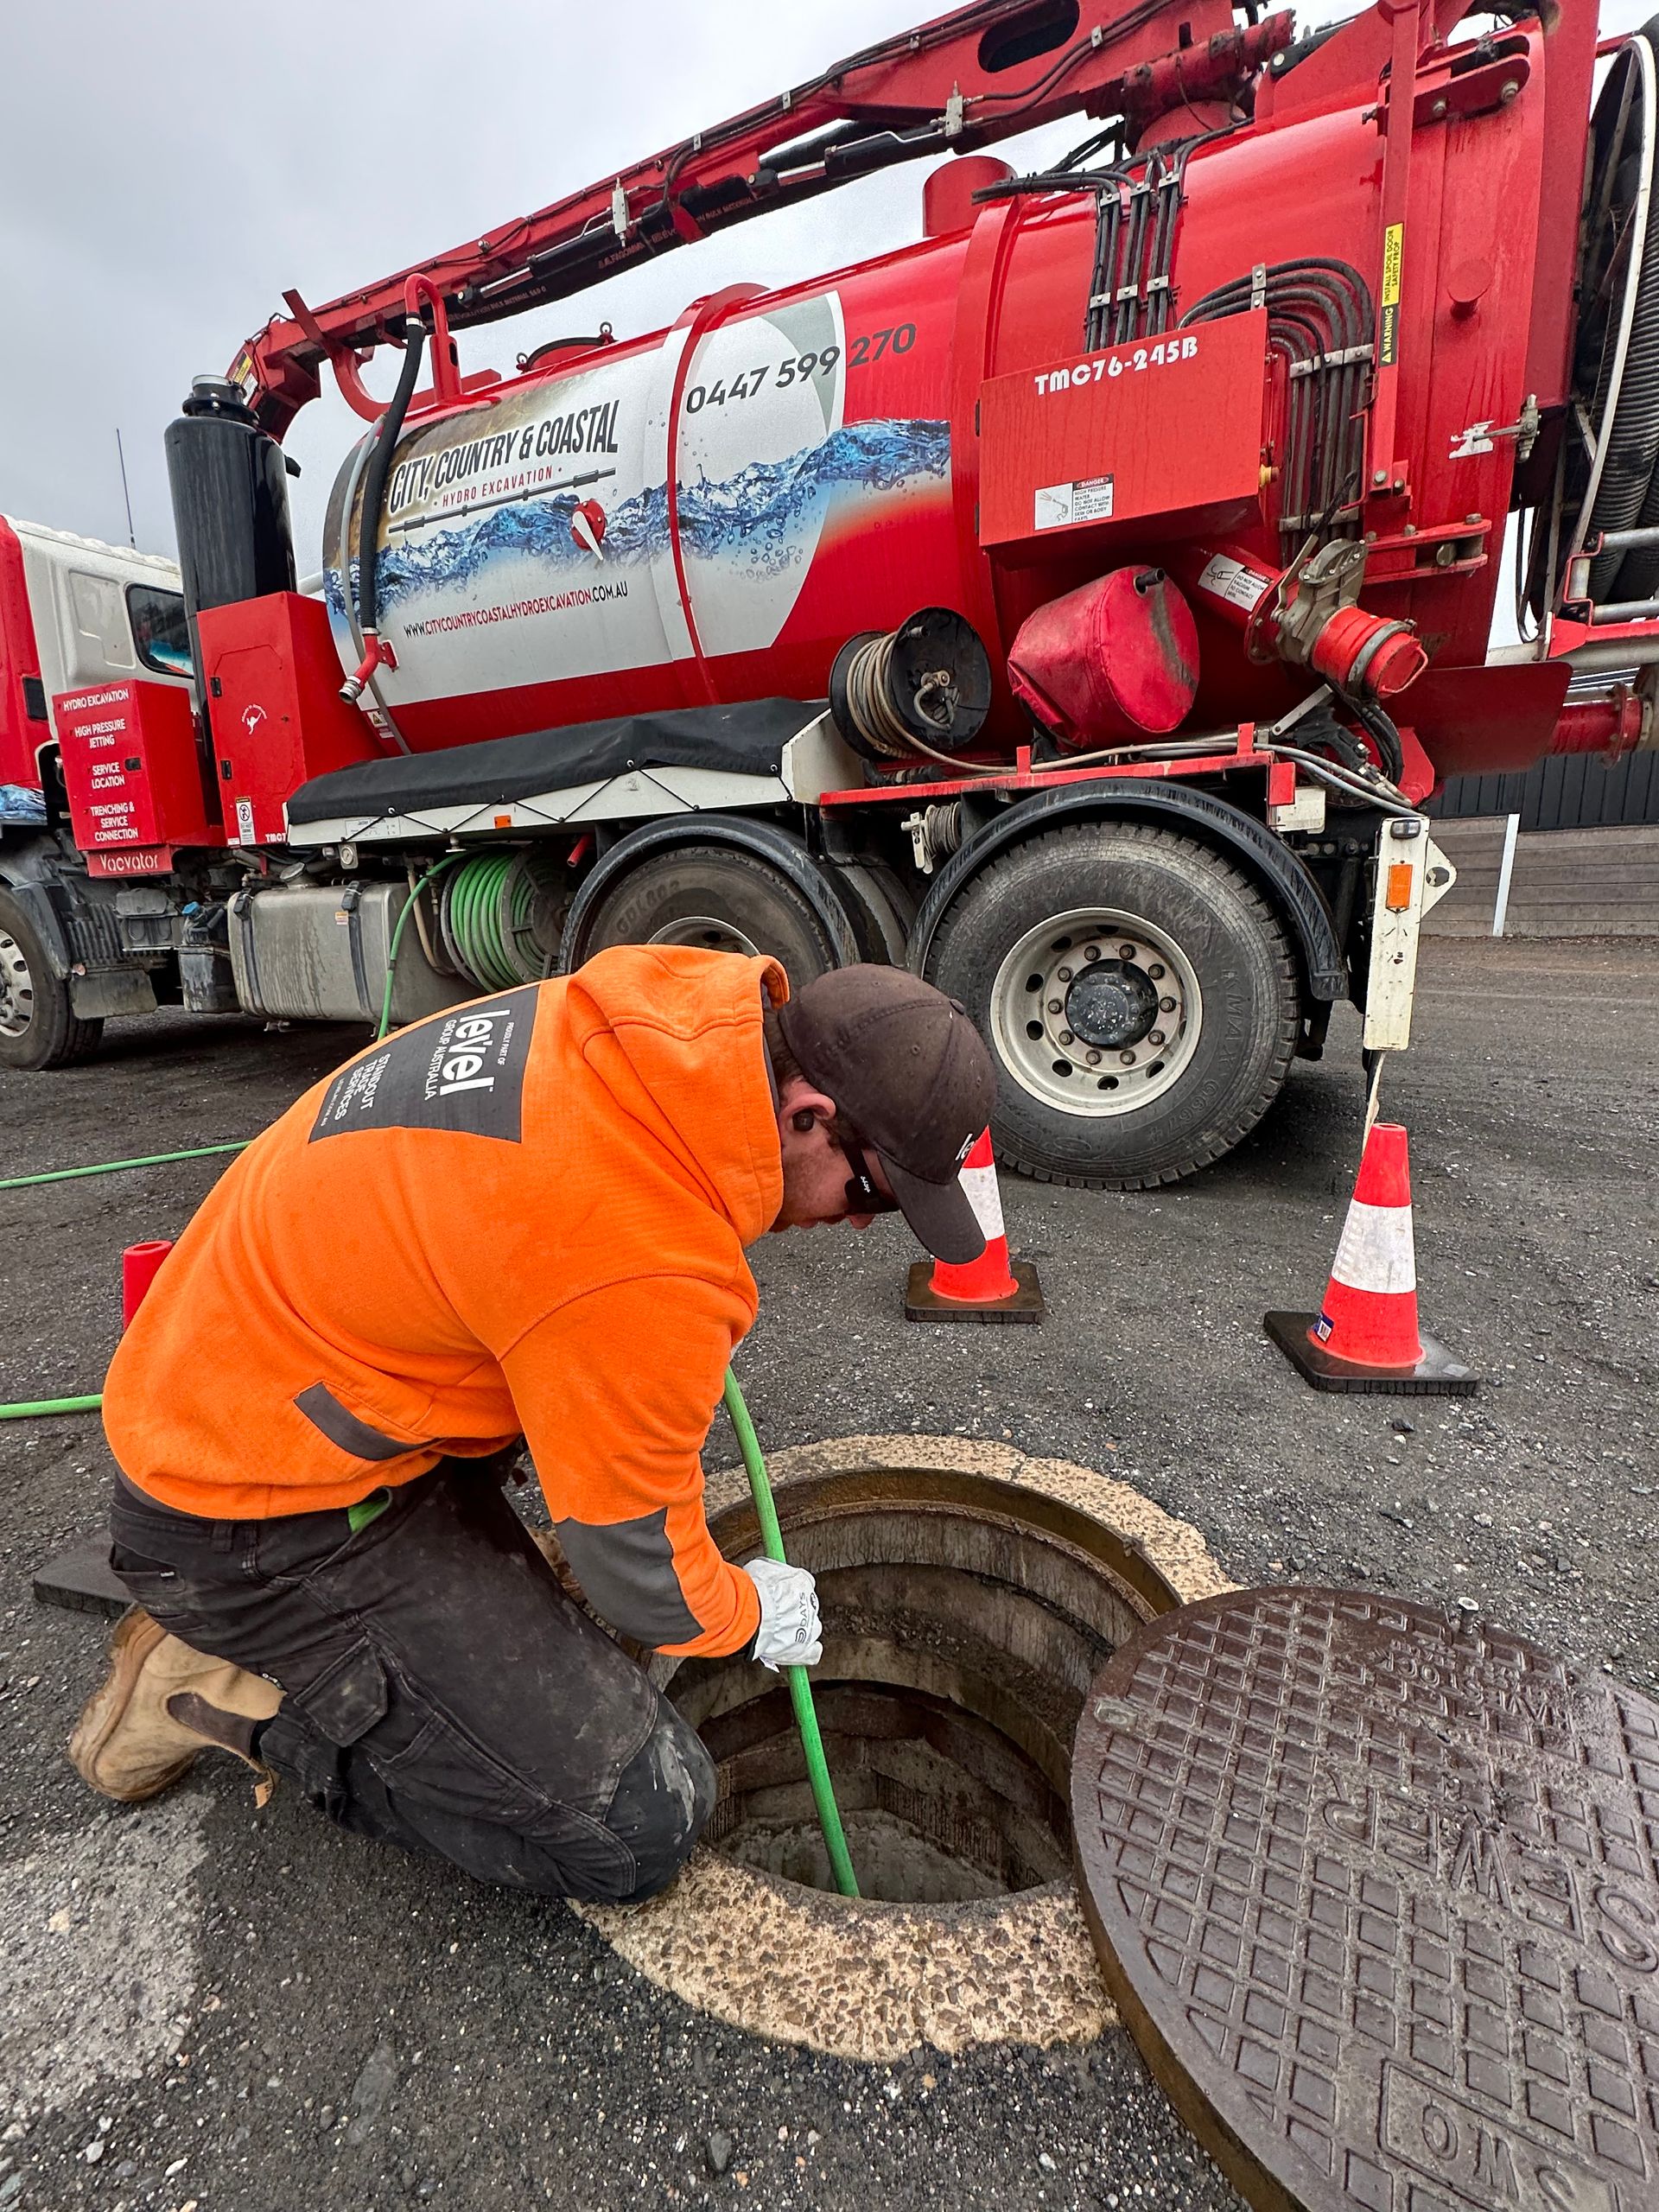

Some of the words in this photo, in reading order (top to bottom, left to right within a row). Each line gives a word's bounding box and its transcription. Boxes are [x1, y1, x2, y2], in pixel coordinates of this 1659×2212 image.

[1382, 307, 1395, 353] WARNING
[686, 365, 770, 414] 0447
[775, 346, 840, 388] 599
[849, 323, 917, 368] 270
[1035, 336, 1198, 395] TMC76-245B
[391, 454, 434, 514] CITY,
[435, 429, 519, 490] COUNTRY
[518, 425, 535, 461] &
[536, 400, 620, 455] COASTAL
[442, 487, 476, 508] HYDRO
[482, 465, 553, 498] EXCAVATION
[1081, 477, 1104, 488] DANGER
[404, 581, 628, 638] WWW.CITYCOUNTRYCOASTALHYDROEXCAVATION.COM.AU
[63, 693, 87, 712] HYDRO
[87, 689, 129, 707] EXCAVATION
[74, 726, 92, 738] HIGH
[92, 718, 125, 734] PRESSURE
[89, 734, 115, 748] JETTING
[92, 761, 120, 776] SERVICE
[92, 776, 124, 789] LOCATION
[90, 802, 129, 817] TRENCHING
[129, 803, 135, 813] &
[100, 815, 129, 828] SERVICE
[94, 828, 138, 842] CONNECTION
[99, 852, 158, 872] Vacvator
[438, 1020, 457, 1046] GROUP
[502, 1022, 514, 1043] PROUDLY
[497, 1057, 505, 1066] OF
[498, 1043, 509, 1057] PART
[353, 1059, 378, 1096] TRADE
[360, 1053, 391, 1110] STANDOUT
[424, 1046, 447, 1101] AUSTRALIA
[334, 1066, 365, 1121] SERVICES
[1324, 1768, 1658, 1974] SEWER
